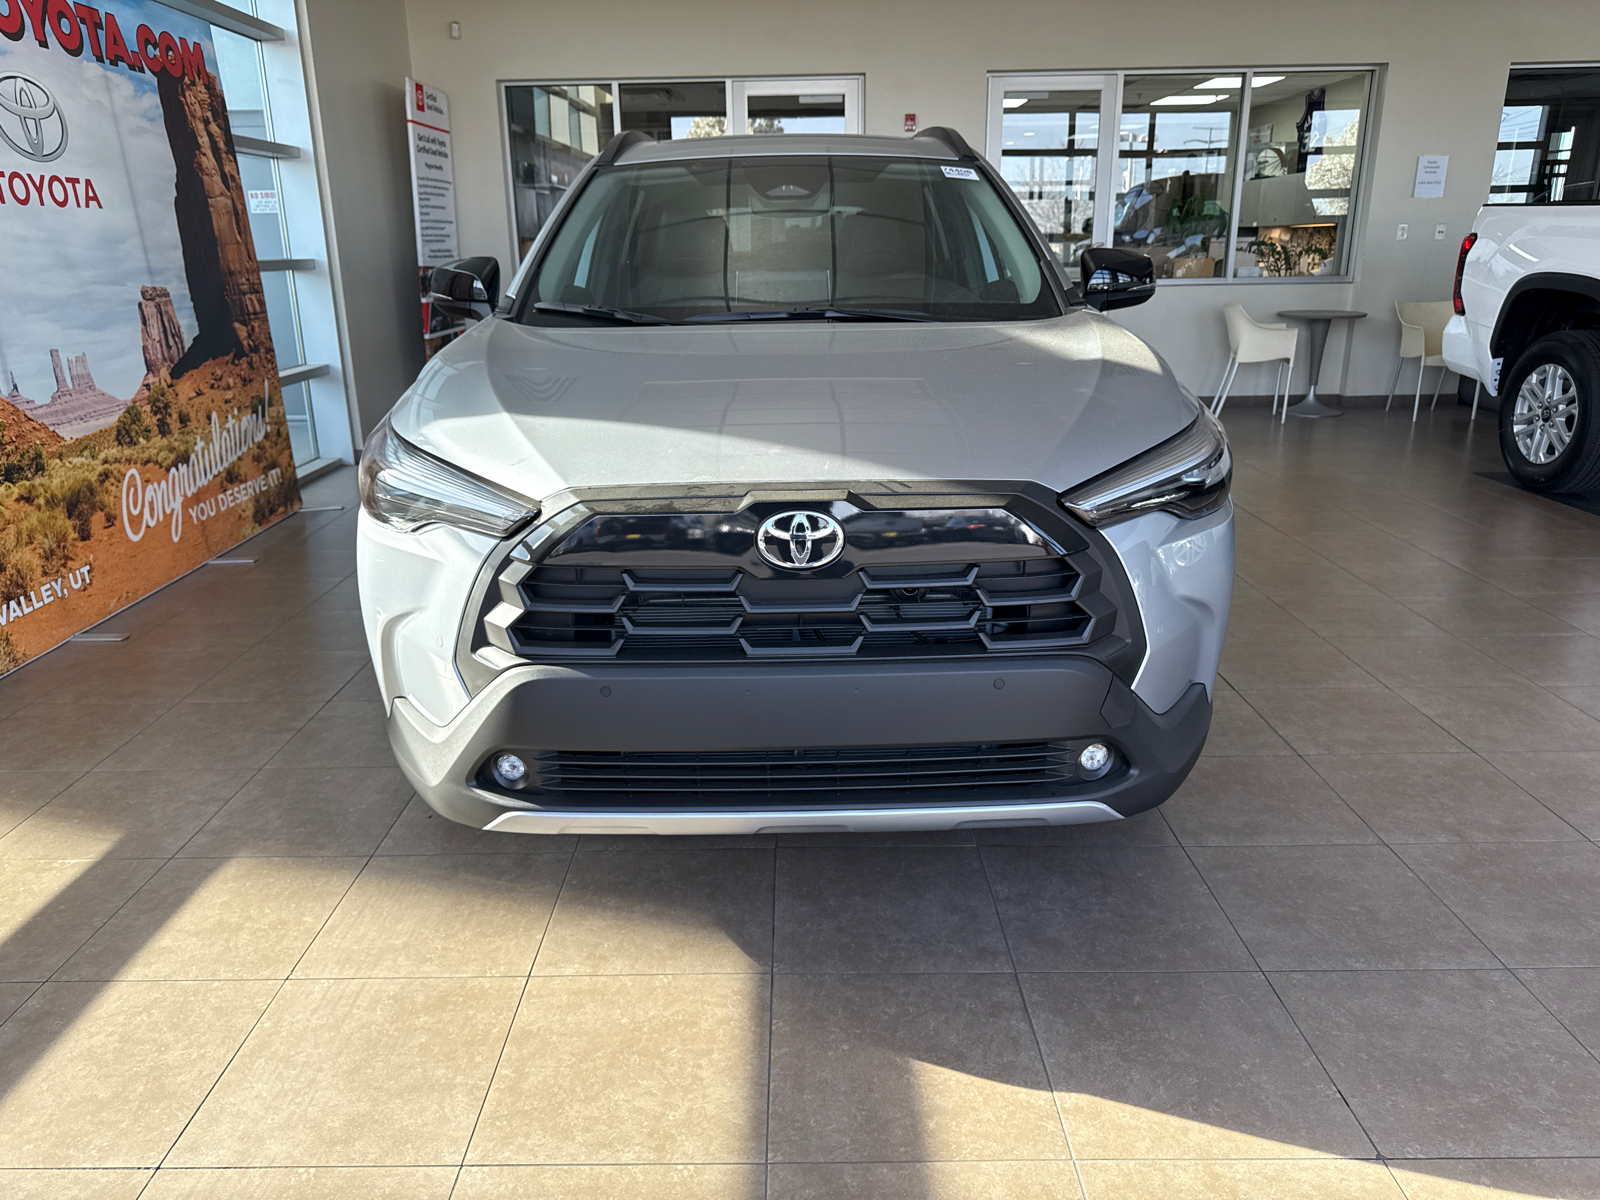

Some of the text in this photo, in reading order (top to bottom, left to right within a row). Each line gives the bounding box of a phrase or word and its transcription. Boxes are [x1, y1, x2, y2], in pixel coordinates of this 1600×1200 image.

[121, 379, 271, 543] Congratulations!
[188, 467, 283, 524] YOU DESERVE IT!
[0, 565, 91, 626] VALLEY, UT
